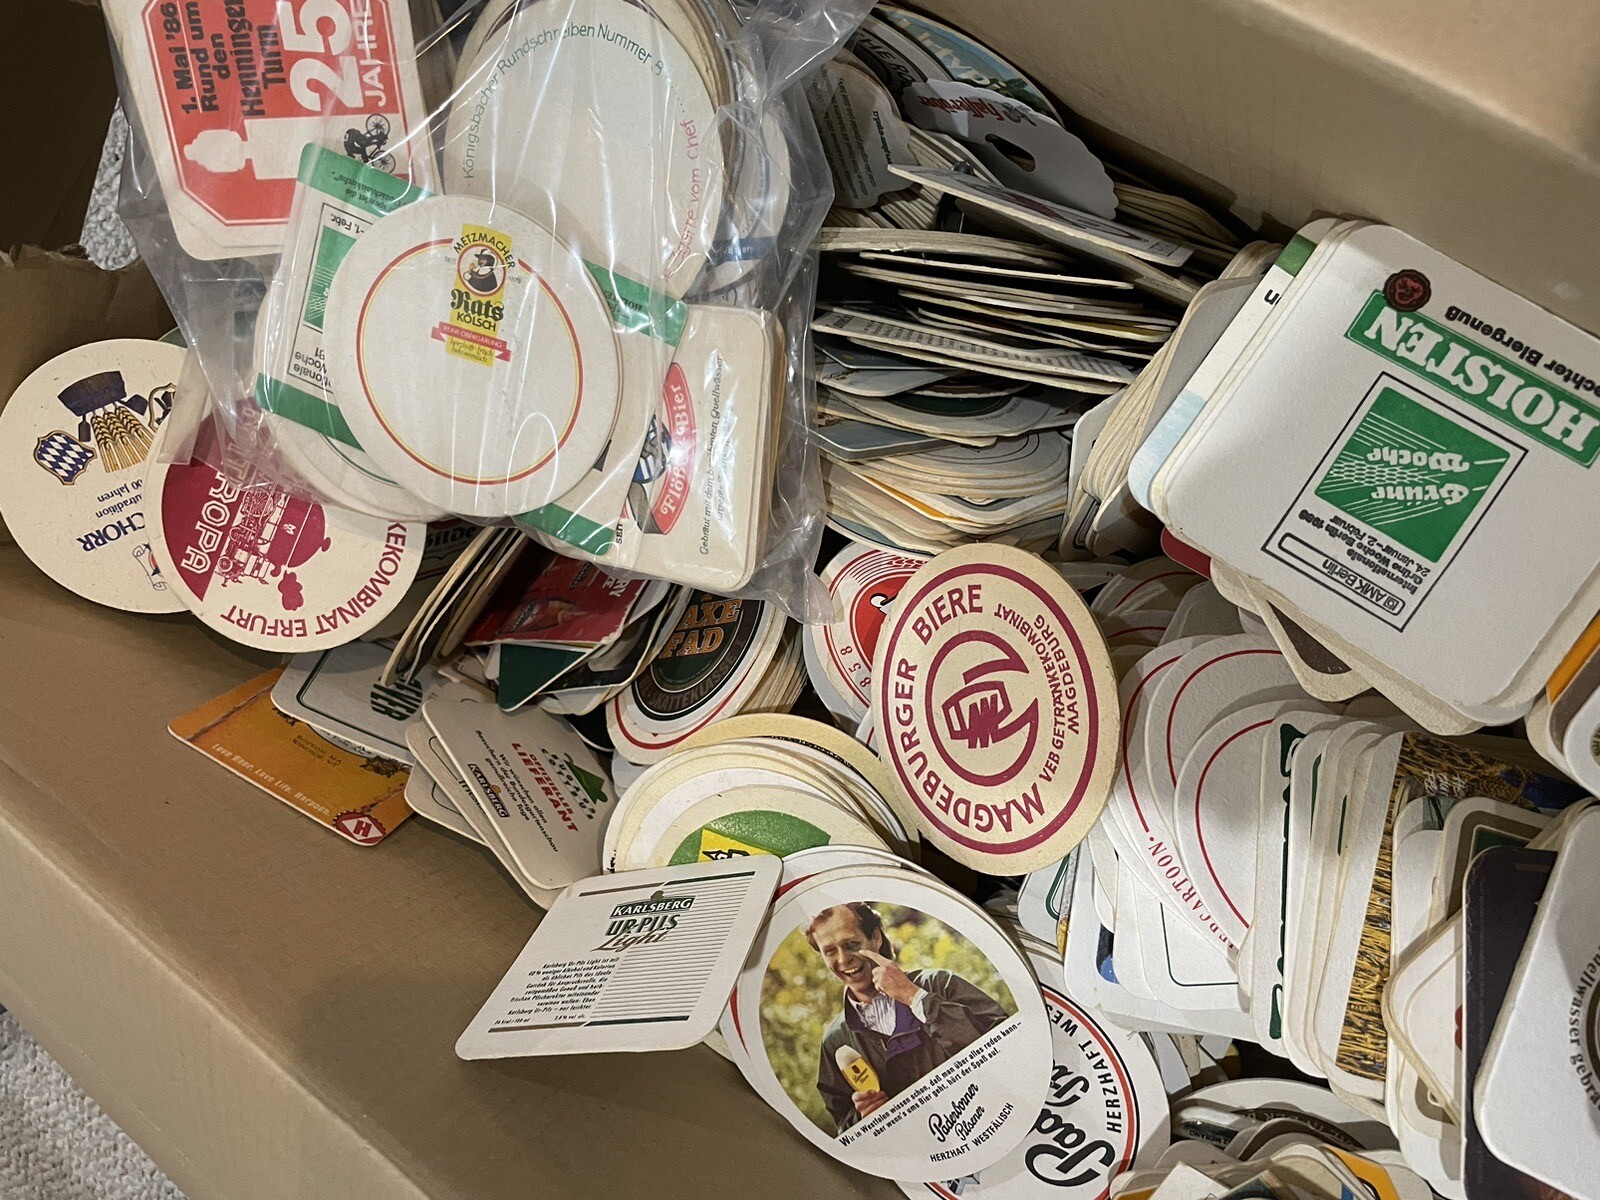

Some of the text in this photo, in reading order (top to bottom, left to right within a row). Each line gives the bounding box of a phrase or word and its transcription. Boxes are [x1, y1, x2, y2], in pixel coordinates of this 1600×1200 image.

[168, 46, 195, 91] Mai
[184, 0, 221, 113] Rund um
[211, 32, 232, 80] den
[256, 24, 287, 91] Turm
[275, 0, 366, 112] 25
[359, 0, 387, 108] JAHRE
[181, 95, 200, 114] 1.
[461, 21, 653, 181] Königsbacher Rundschreiben Nummer
[679, 117, 702, 203] vom Chef
[330, 212, 353, 231] Febr.
[453, 231, 517, 269] METZMACHER
[450, 288, 505, 322] Rats
[456, 311, 497, 332] KÖLSCH
[1444, 305, 1545, 368] Biergenuß
[1363, 305, 1600, 453] HOLSTEN
[671, 383, 691, 437] Bier
[1366, 446, 1470, 474] Woche
[96, 482, 131, 503] Jahren
[1370, 481, 1470, 508] Grüne
[1324, 523, 1356, 548] Berlin
[1328, 514, 1368, 541] Februar
[1346, 547, 1419, 596] Internationale
[1355, 540, 1392, 568] Woche
[1391, 561, 1424, 586] Grüne
[1414, 561, 1432, 578] 24.
[219, 604, 309, 638] ERFURT
[677, 597, 743, 631] AXE
[658, 625, 726, 661] FAD
[1033, 613, 1080, 735] MAGDEBURG
[895, 584, 1046, 834] MAGDEBURGER BIERE
[211, 742, 232, 759] Love
[254, 767, 275, 784] Love
[529, 753, 574, 815] OFFIZIELLER
[541, 747, 594, 820] COTTBUS
[551, 753, 580, 793] BUGA
[1038, 752, 1061, 783] VEB
[467, 763, 511, 819] KARLSBERG
[499, 753, 548, 824] Wir wünschen allen
[511, 742, 580, 832] LIEFERANT
[352, 818, 373, 839] H
[500, 766, 511, 780] der
[508, 780, 559, 852] Bundesgartenschau
[516, 802, 531, 822] Tage
[604, 912, 682, 937] UR-PILS
[611, 897, 694, 918] KARLSBERG
[589, 928, 671, 954] Light
[839, 1131, 856, 1148] Wir
[860, 1109, 891, 1135] Westfalen
[889, 1097, 911, 1115] wissen
[910, 1084, 931, 1103] schon,
[929, 1074, 943, 1088] daß
[940, 1067, 954, 1080] man
[952, 1056, 970, 1072] über
[968, 1046, 985, 1062] alles
[983, 1035, 1003, 1051] reden
[872, 1126, 887, 1139] aber
[907, 1102, 921, 1115] ums
[919, 1092, 933, 1107] Bier
[931, 1084, 949, 1100] geht,
[947, 1074, 962, 1088] hört
[960, 1066, 973, 1079] der
[971, 1055, 990, 1073] Spaß
[987, 1047, 1003, 1062] auf.
[1077, 1038, 1123, 1134] HERZHAFT
[928, 1082, 979, 1143] Paderborner
[929, 1101, 1015, 1164] HERZHAFT WESTFÄLISCH
[954, 1105, 985, 1142] Pilsener
